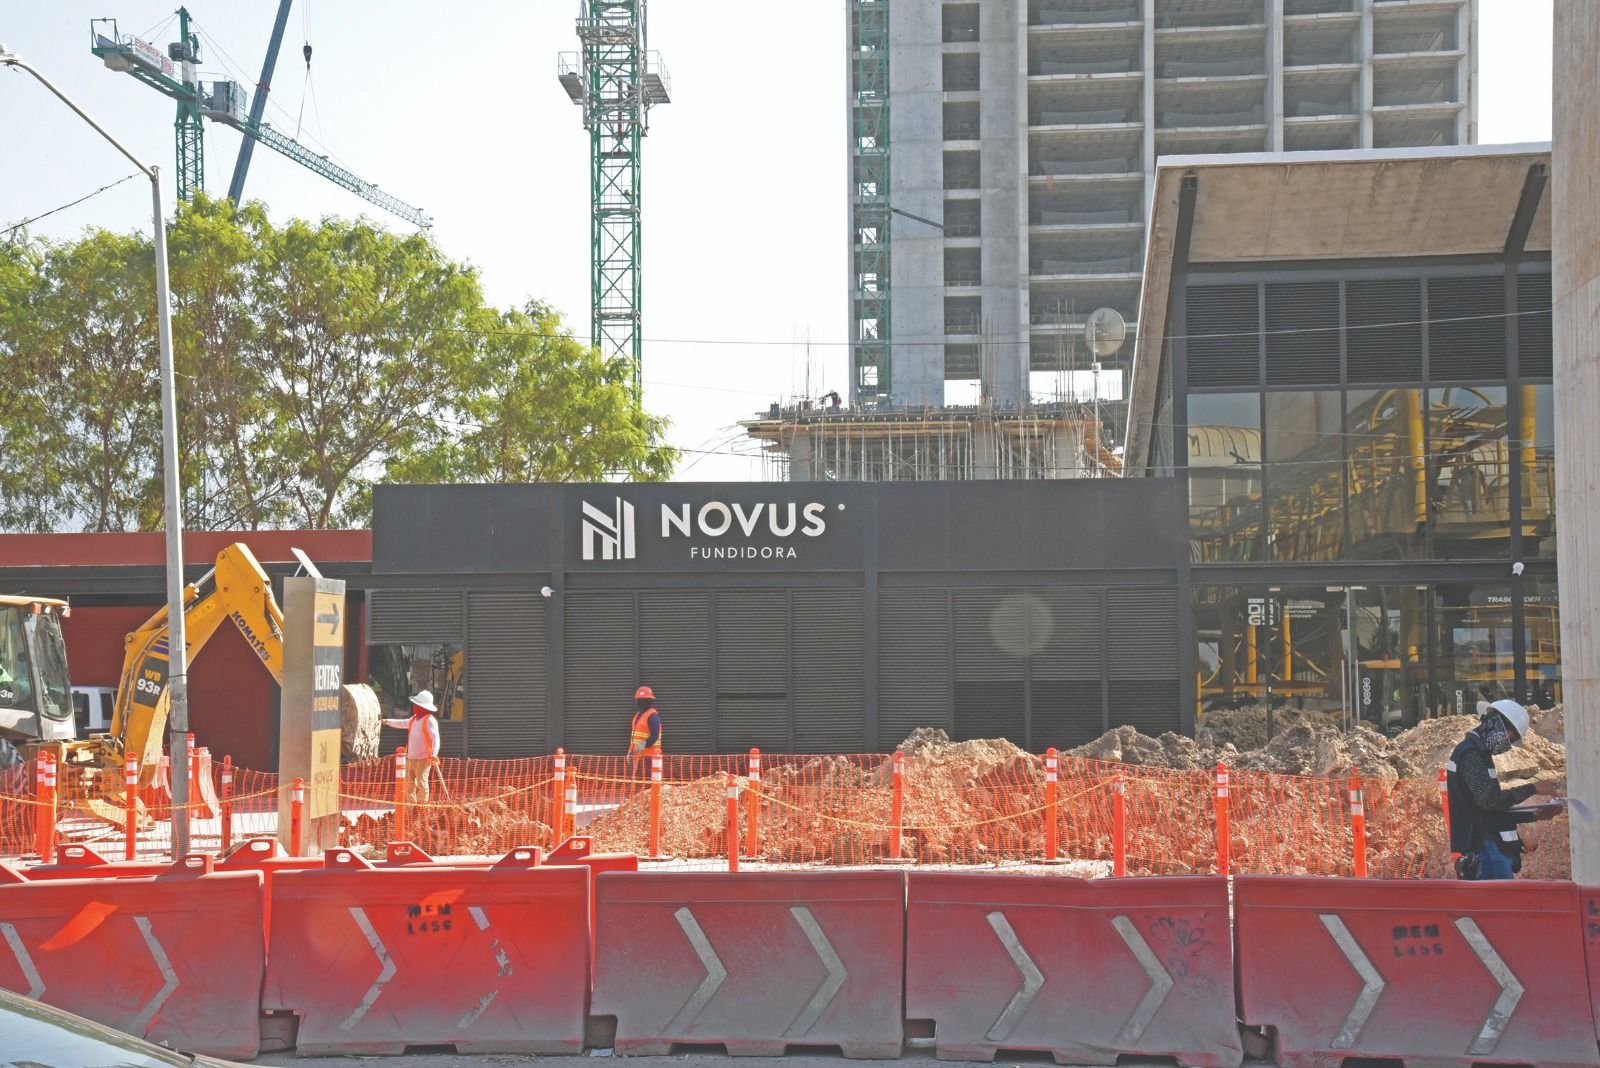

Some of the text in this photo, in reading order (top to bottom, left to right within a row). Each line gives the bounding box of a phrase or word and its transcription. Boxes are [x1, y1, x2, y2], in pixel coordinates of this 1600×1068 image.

[661, 501, 826, 538] NOVUS
[690, 547, 798, 559] FUNDIDORA
[232, 610, 271, 660] KOMATSU
[144, 668, 161, 682] WB
[314, 664, 340, 690] VENTAS
[137, 678, 161, 696] 93R
